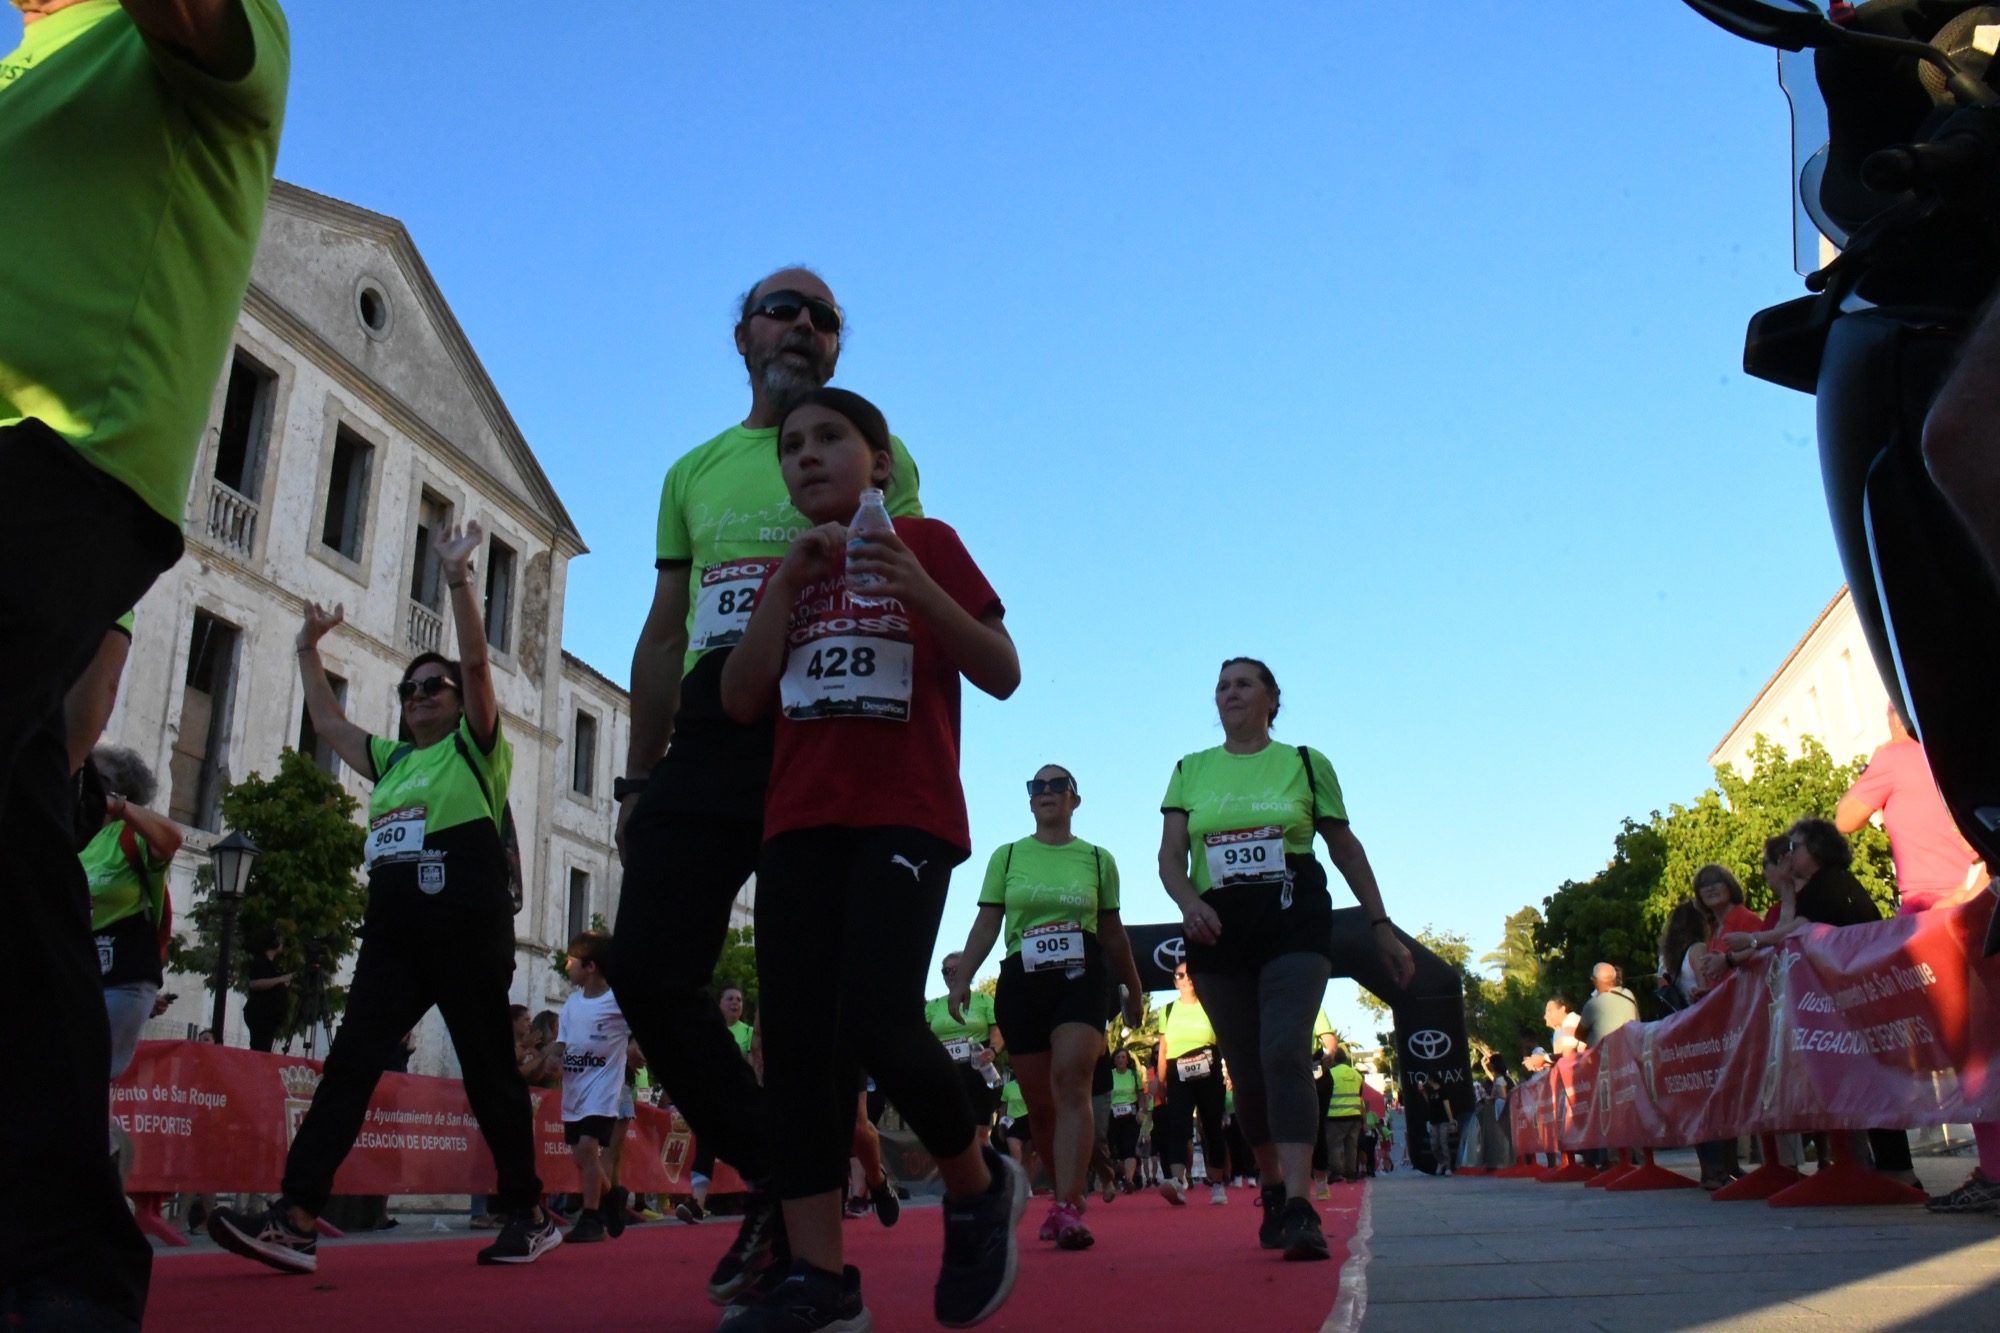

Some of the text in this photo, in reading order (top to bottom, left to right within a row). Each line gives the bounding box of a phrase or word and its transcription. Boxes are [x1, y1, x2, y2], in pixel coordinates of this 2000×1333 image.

[702, 563, 770, 584] CRO
[717, 587, 757, 616] 82
[790, 614, 910, 644] CROSS
[807, 646, 877, 681] 428
[372, 806, 425, 830] CROSS
[374, 826, 407, 848] 960
[1206, 825, 1282, 845] CROSS
[1224, 846, 1267, 865] 930
[1023, 921, 1080, 938] CROSS
[1036, 937, 1070, 954] 905
[1890, 962, 1937, 995] Roque
[949, 1046, 962, 1055] 16
[1184, 1063, 1201, 1073] 907
[152, 1084, 168, 1101] de
[171, 1085, 187, 1103] San
[189, 1087, 227, 1110] Roque
[134, 1114, 193, 1136] DEPORTES
[373, 1107, 433, 1126] Ayuntamiento
[434, 1111, 445, 1126] de
[446, 1112, 461, 1127] San
[462, 1113, 480, 1131] Roq
[353, 1130, 468, 1152] LEGACIÓN DE DEPORTES
